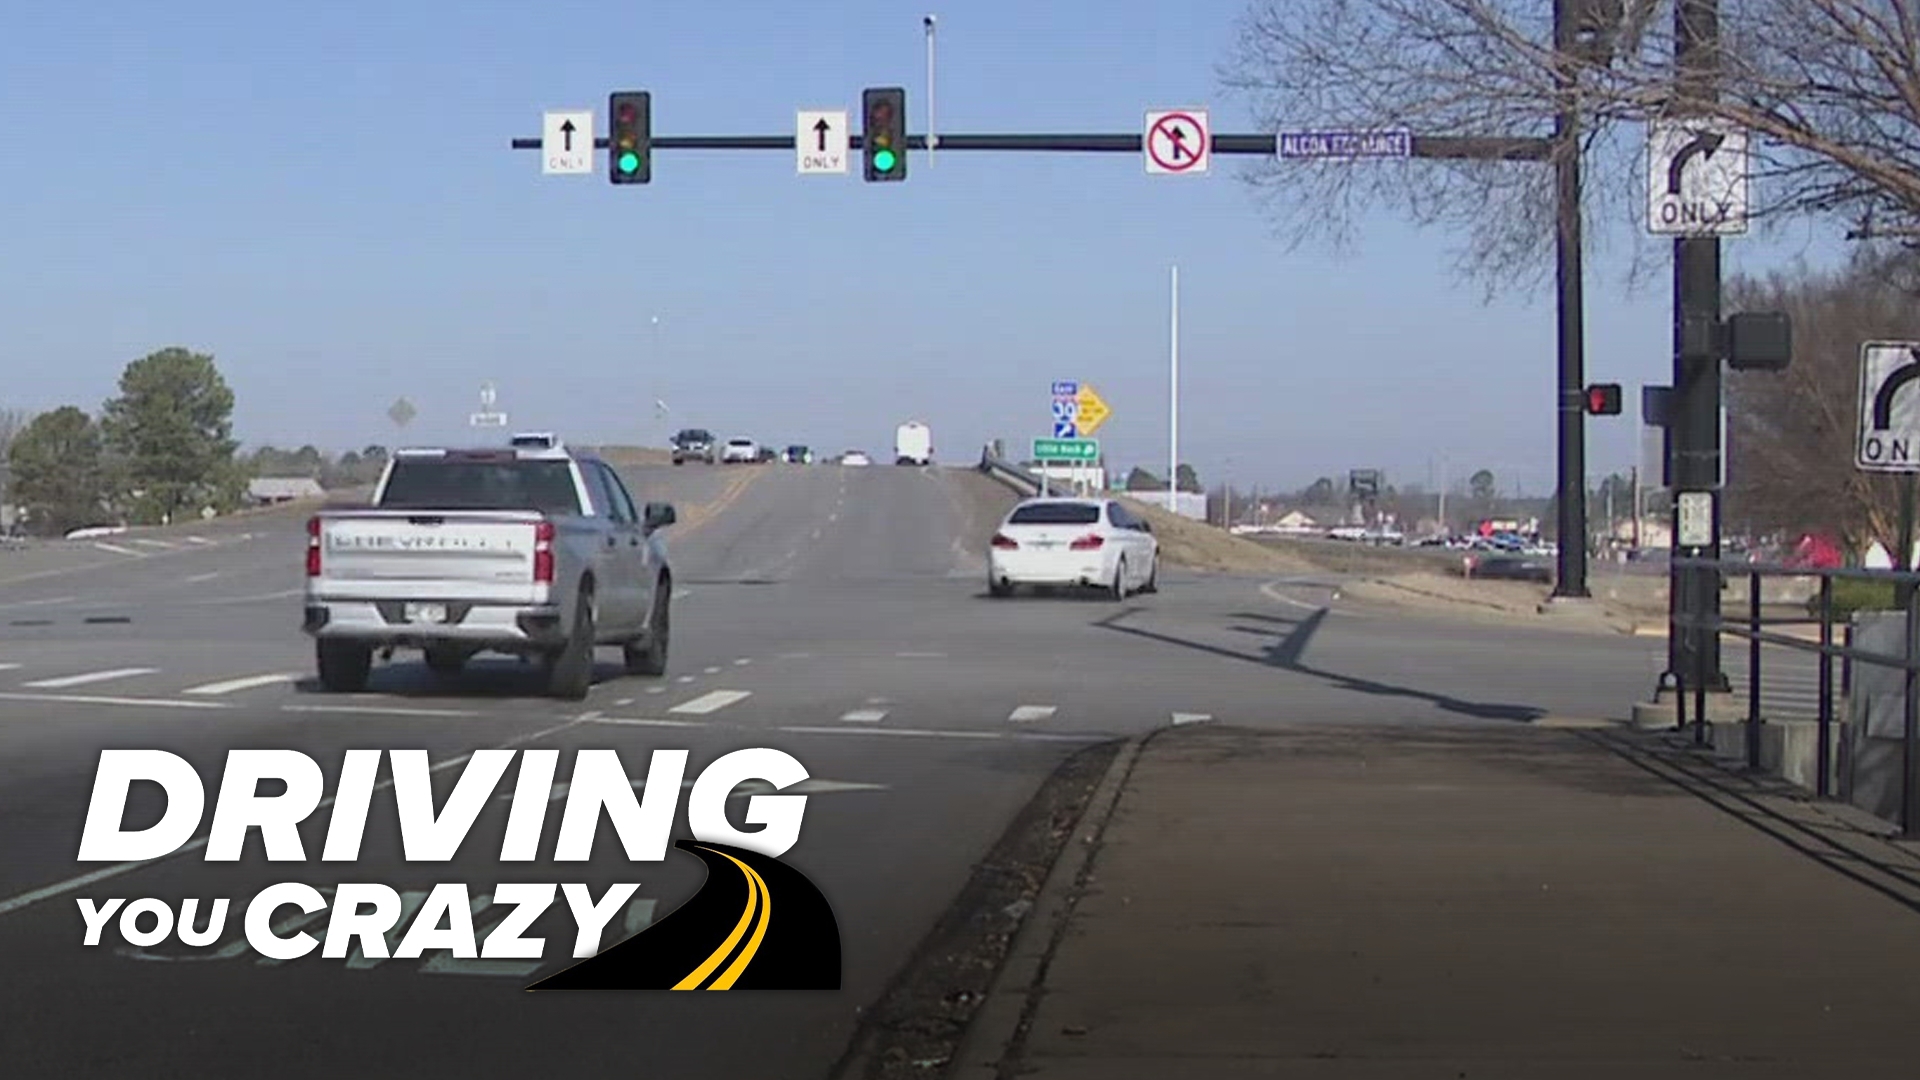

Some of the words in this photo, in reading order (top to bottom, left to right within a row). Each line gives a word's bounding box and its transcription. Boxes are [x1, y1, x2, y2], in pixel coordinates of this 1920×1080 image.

[1283, 136, 1328, 154] ALCOA
[804, 156, 841, 169] ONLY
[1661, 202, 1730, 225] ONLY
